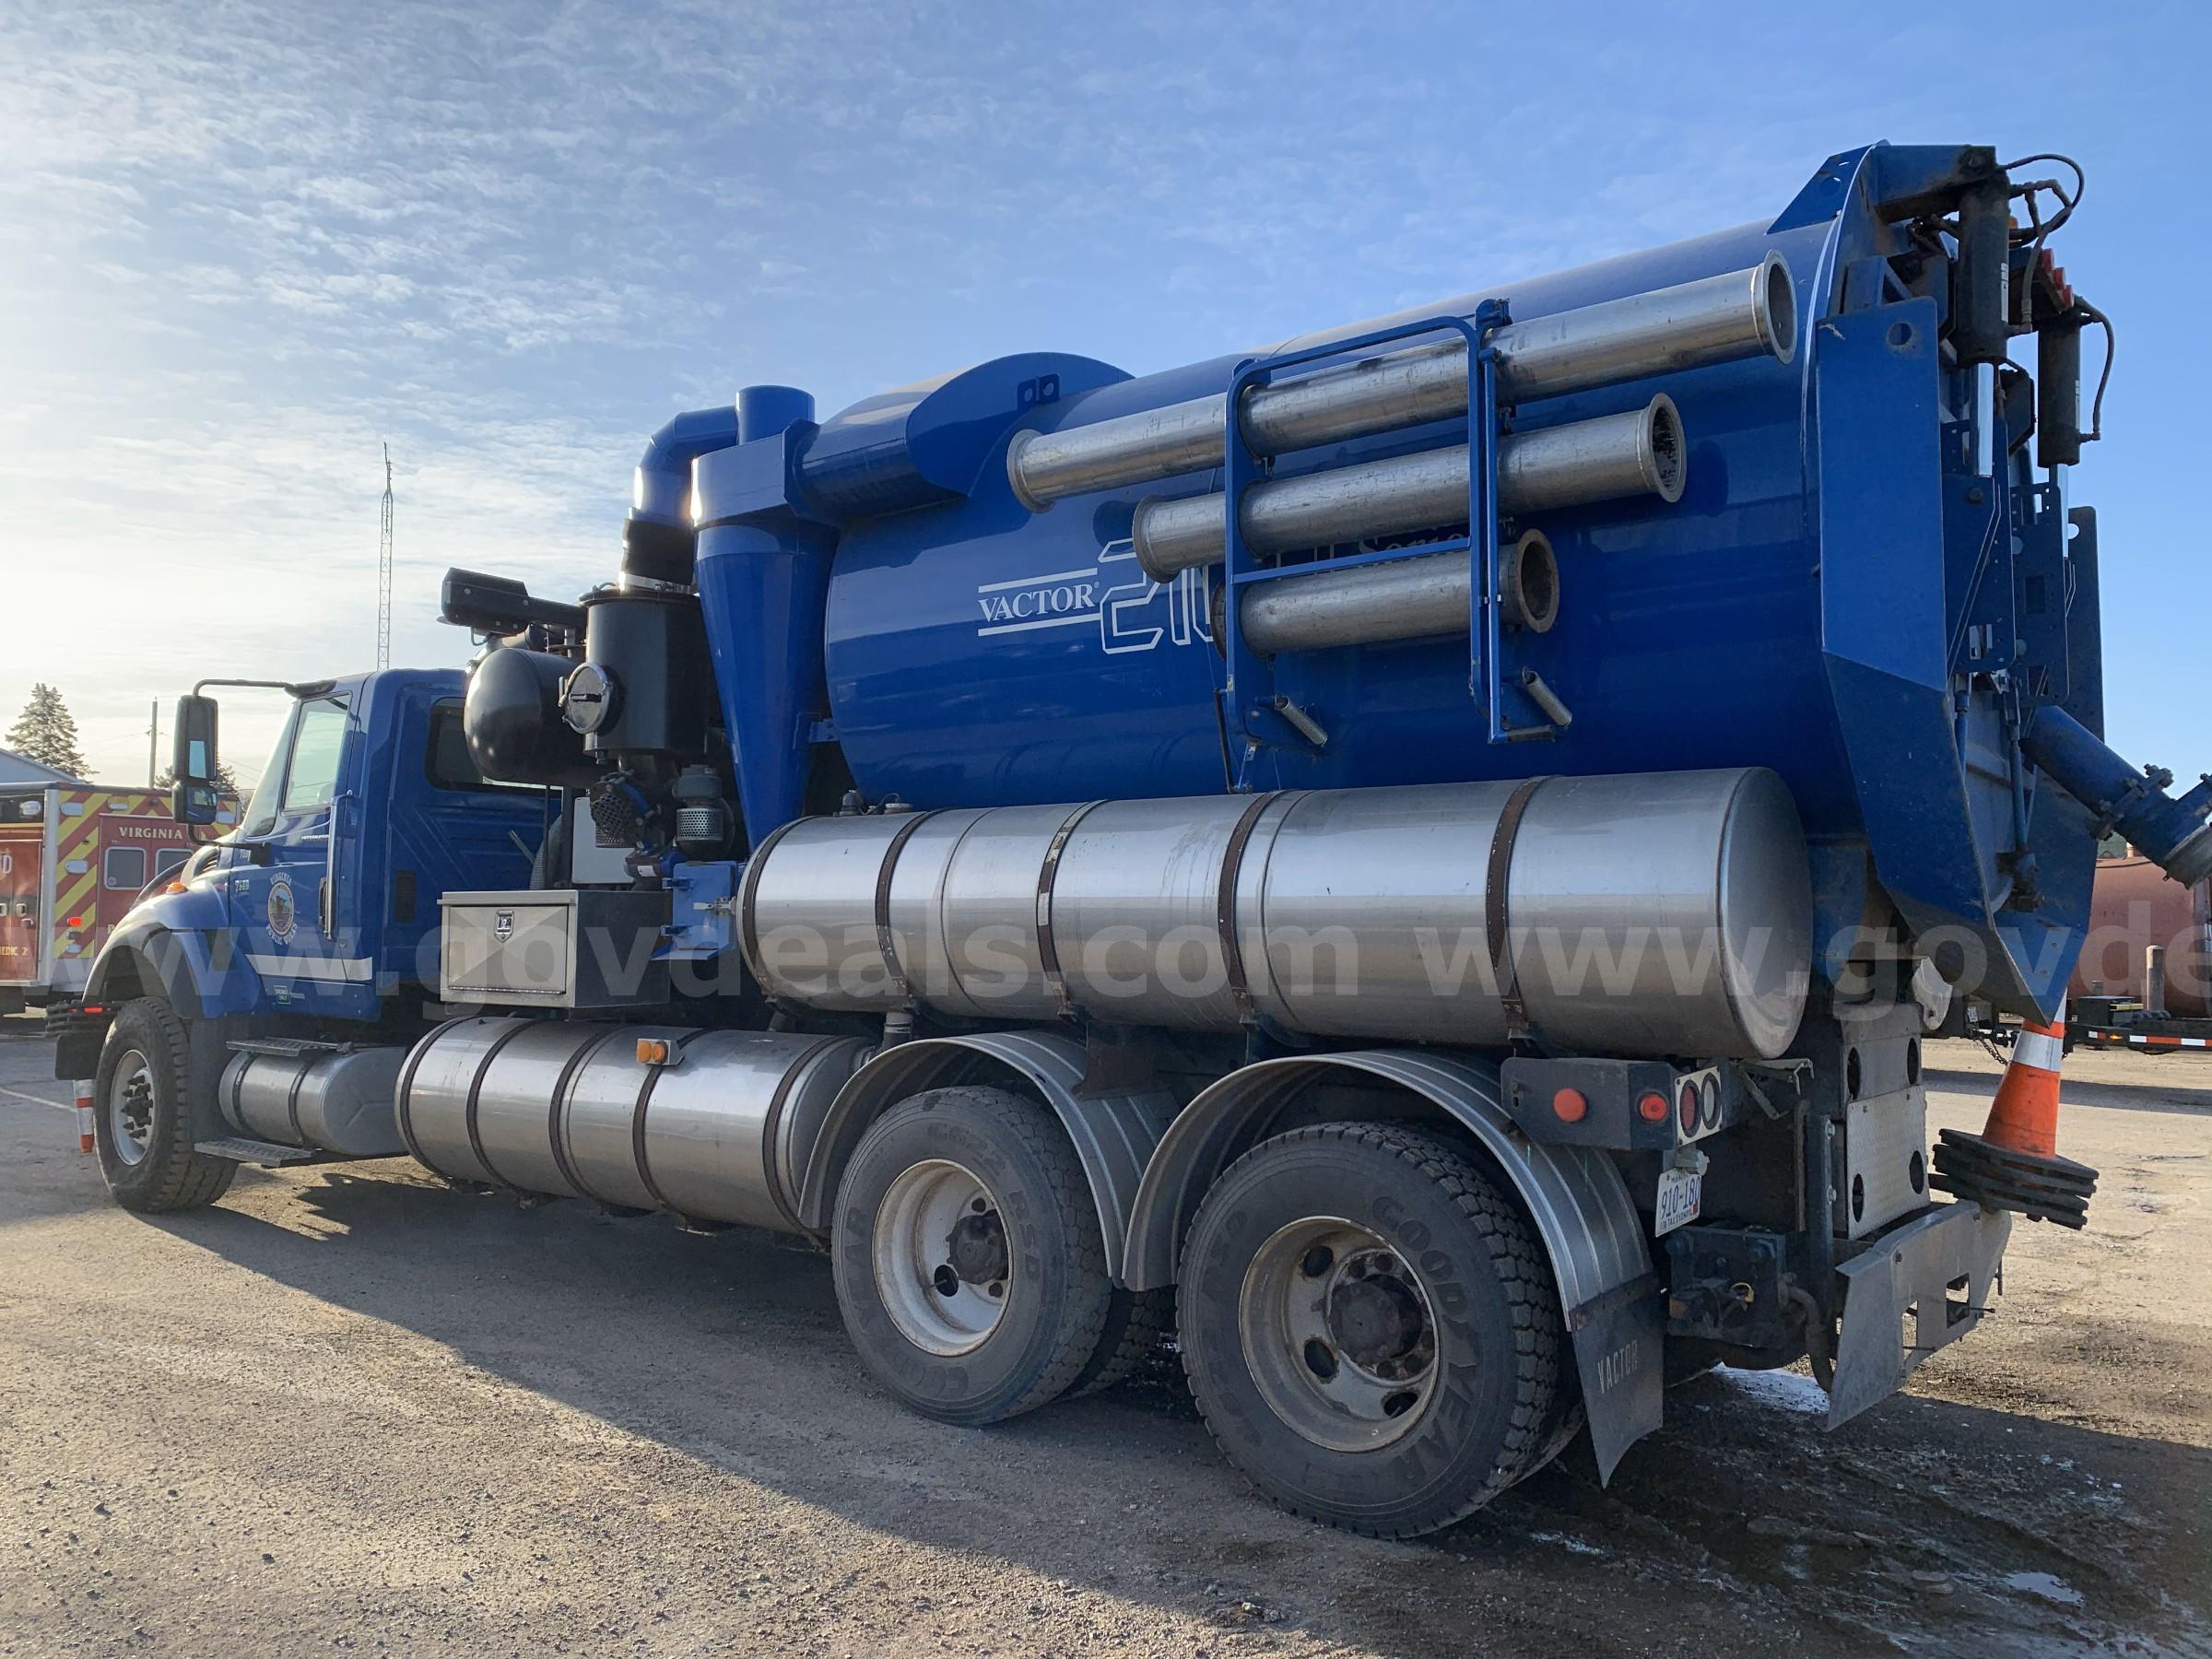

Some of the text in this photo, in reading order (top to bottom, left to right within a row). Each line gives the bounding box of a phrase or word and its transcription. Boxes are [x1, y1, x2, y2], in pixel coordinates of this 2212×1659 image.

[119, 827, 182, 840] VIRGINIA
[0, 946, 29, 956] EDIC 2
[1660, 1176, 1700, 1218] 910-180
[1371, 1194, 1478, 1478] GOODYEAR
[1596, 1339, 1639, 1394] VACTOR
